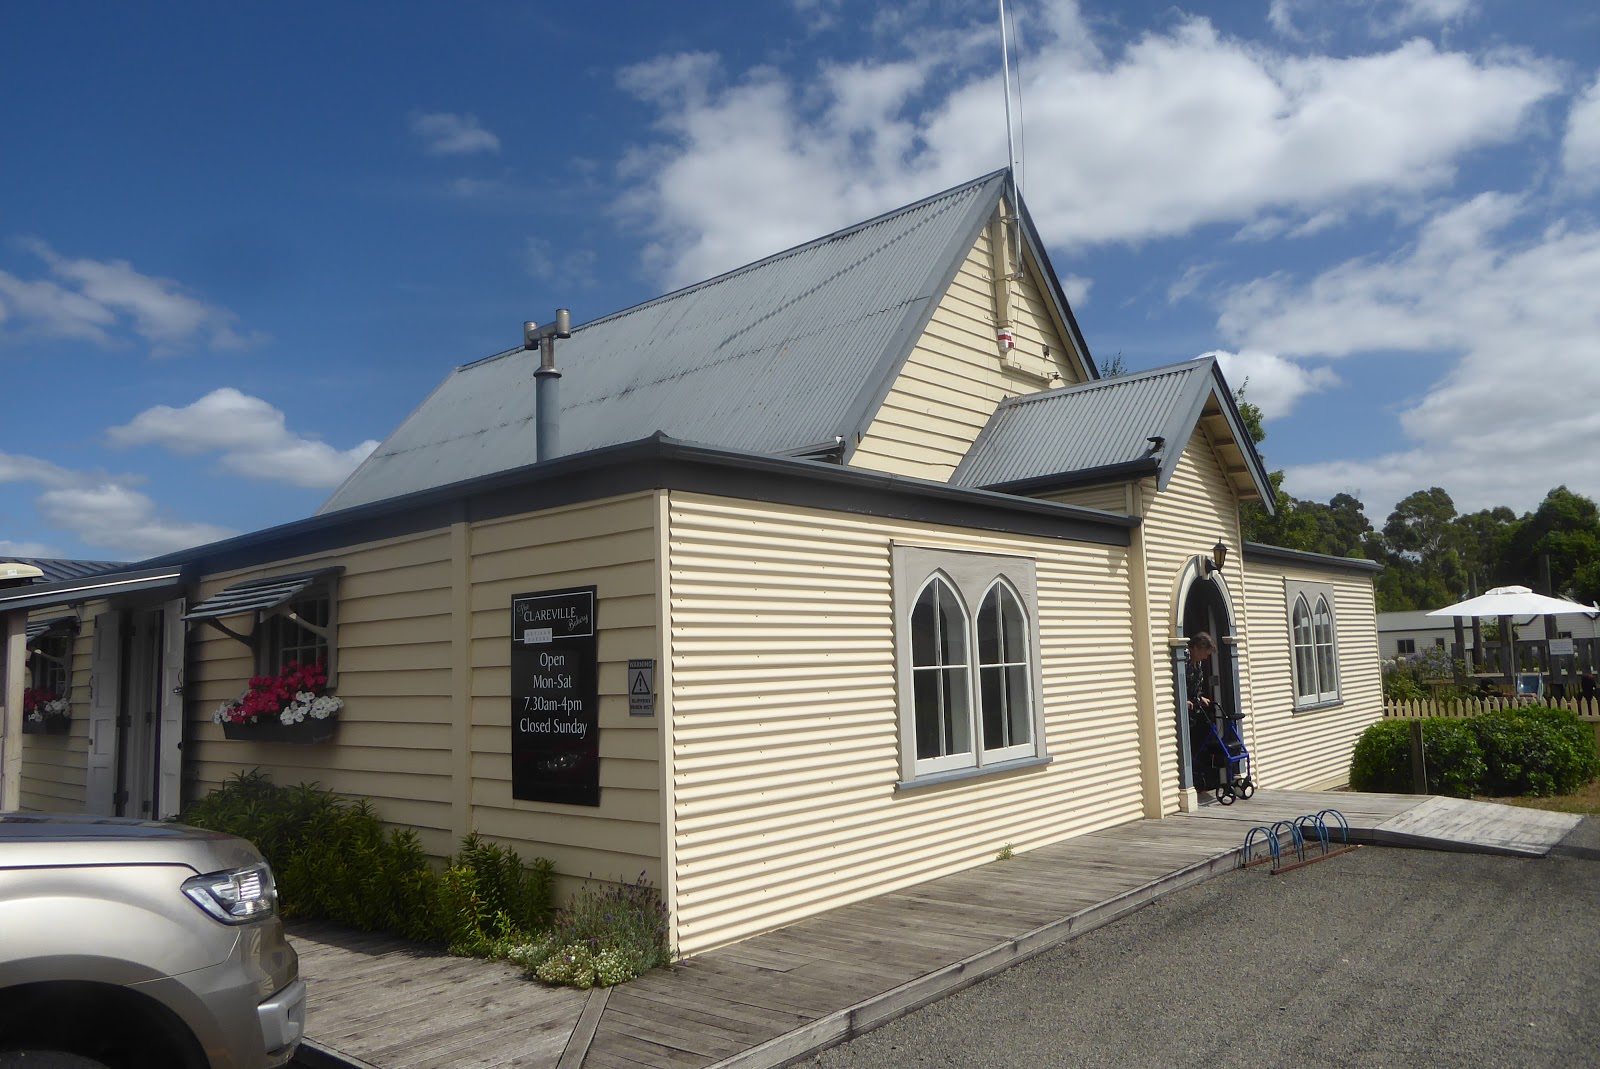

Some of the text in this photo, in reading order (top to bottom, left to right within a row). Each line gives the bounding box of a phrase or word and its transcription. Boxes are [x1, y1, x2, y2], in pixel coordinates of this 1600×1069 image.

[524, 607, 576, 622] CLAREVILLE
[540, 652, 565, 671] Open
[533, 674, 572, 689] Mon-Sat
[524, 696, 582, 716] 7.30am-4pm
[520, 717, 588, 740] Closed Sunday
